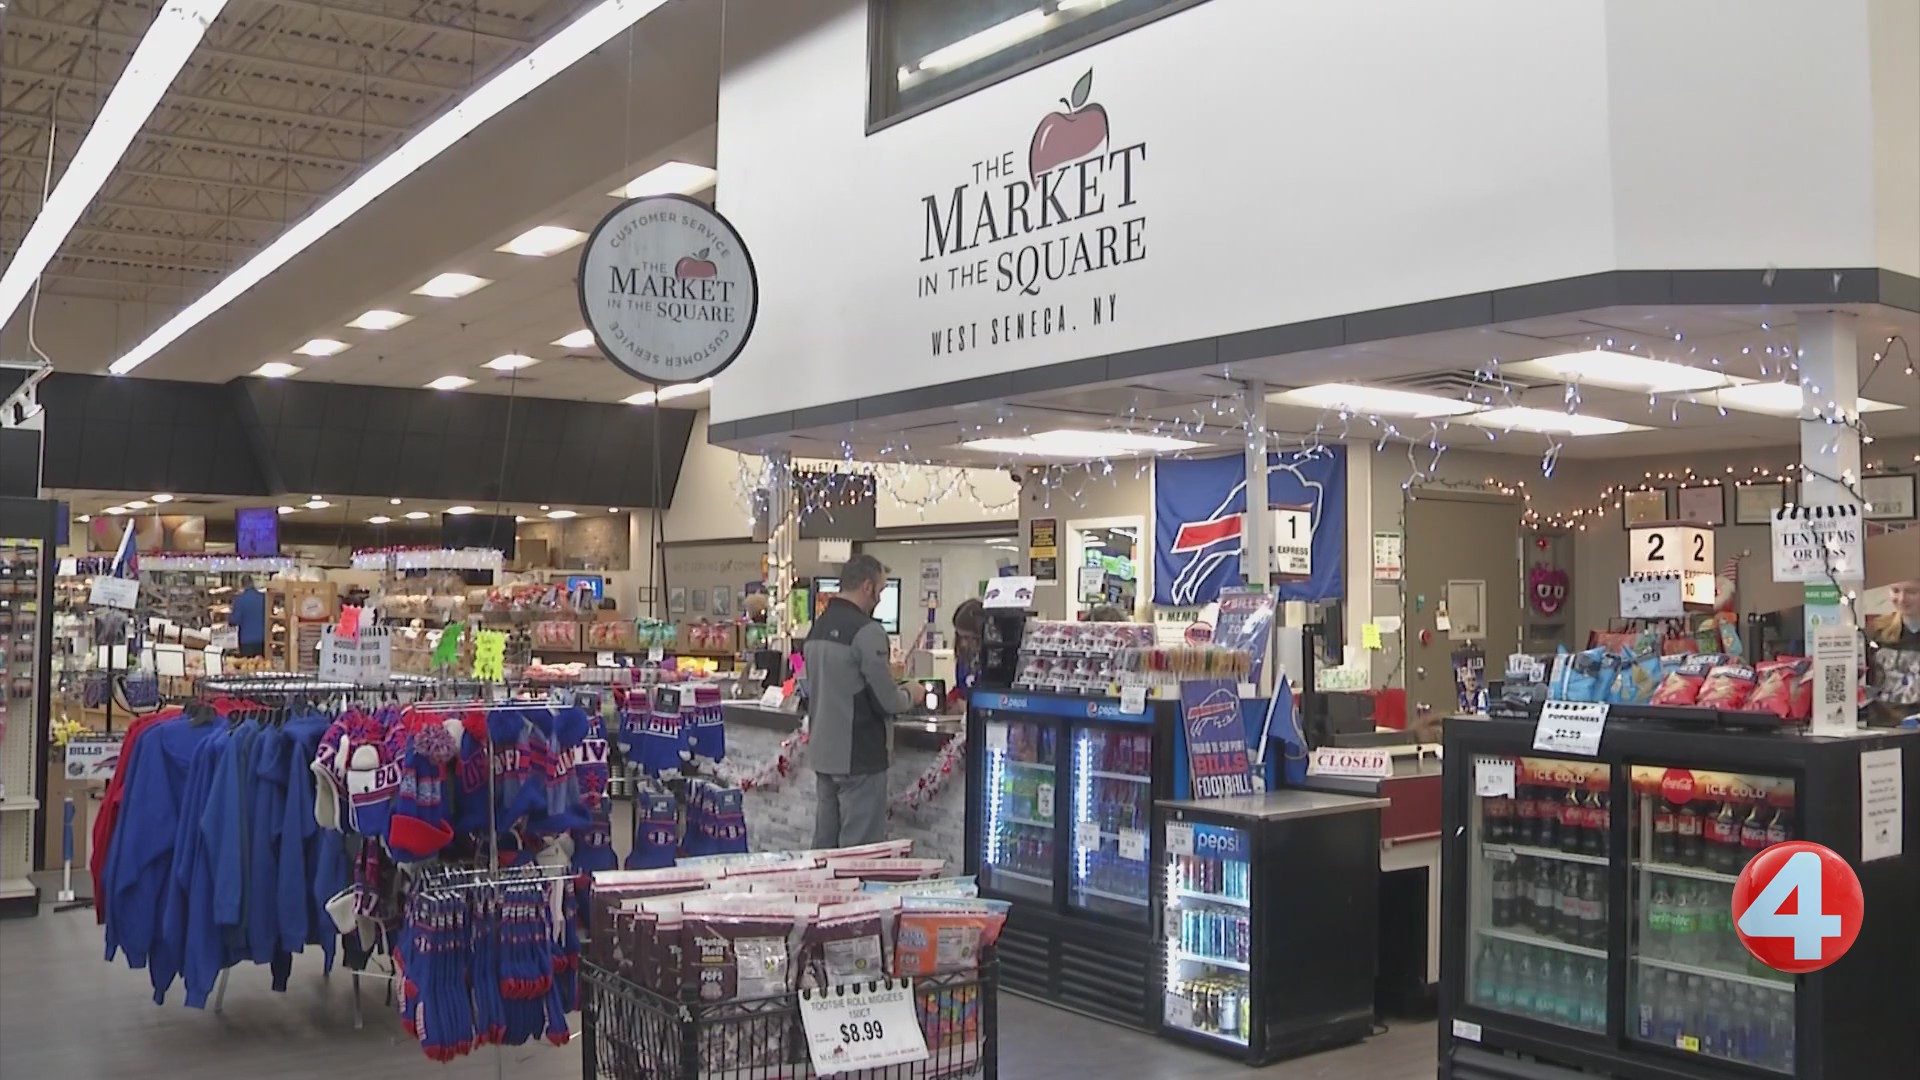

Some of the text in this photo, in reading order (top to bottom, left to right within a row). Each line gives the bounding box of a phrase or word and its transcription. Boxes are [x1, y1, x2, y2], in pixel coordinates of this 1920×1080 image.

[972, 151, 1014, 185] THE
[920, 142, 1146, 262] MARKET
[610, 212, 731, 259] CUSTOMER SERVICE
[642, 261, 668, 273] THE
[918, 217, 1146, 298] IN THE SQUARE
[609, 265, 735, 303] MARKET
[608, 299, 735, 323] IN THE SQUARE
[931, 323, 977, 356] WEST
[1093, 293, 1116, 325] NY
[609, 321, 730, 367] CUSTOMER SERVICE
[1288, 515, 1296, 539] 1
[1277, 545, 1309, 556] EXPRESS
[1648, 533, 1664, 561] 2
[1693, 533, 1704, 562] 2
[1781, 533, 1810, 546] TEN
[1793, 549, 1812, 559] OR
[1685, 582, 1695, 596] 10
[1547, 713, 1600, 723] POPCORNERS
[69, 746, 102, 756] BILLS
[1317, 754, 1384, 769] CLOSED
[1193, 752, 1249, 776] BILLS
[1196, 773, 1252, 797] FOOTBALL
[1533, 769, 1587, 784] ICE COLD
[1705, 783, 1727, 796] ICE
[1730, 785, 1767, 799] COLD
[1197, 831, 1240, 852] pepsi
[811, 1000, 845, 1011] TOOTSIE
[847, 997, 866, 1007] ROLL
[840, 1020, 884, 1044] $8.99
